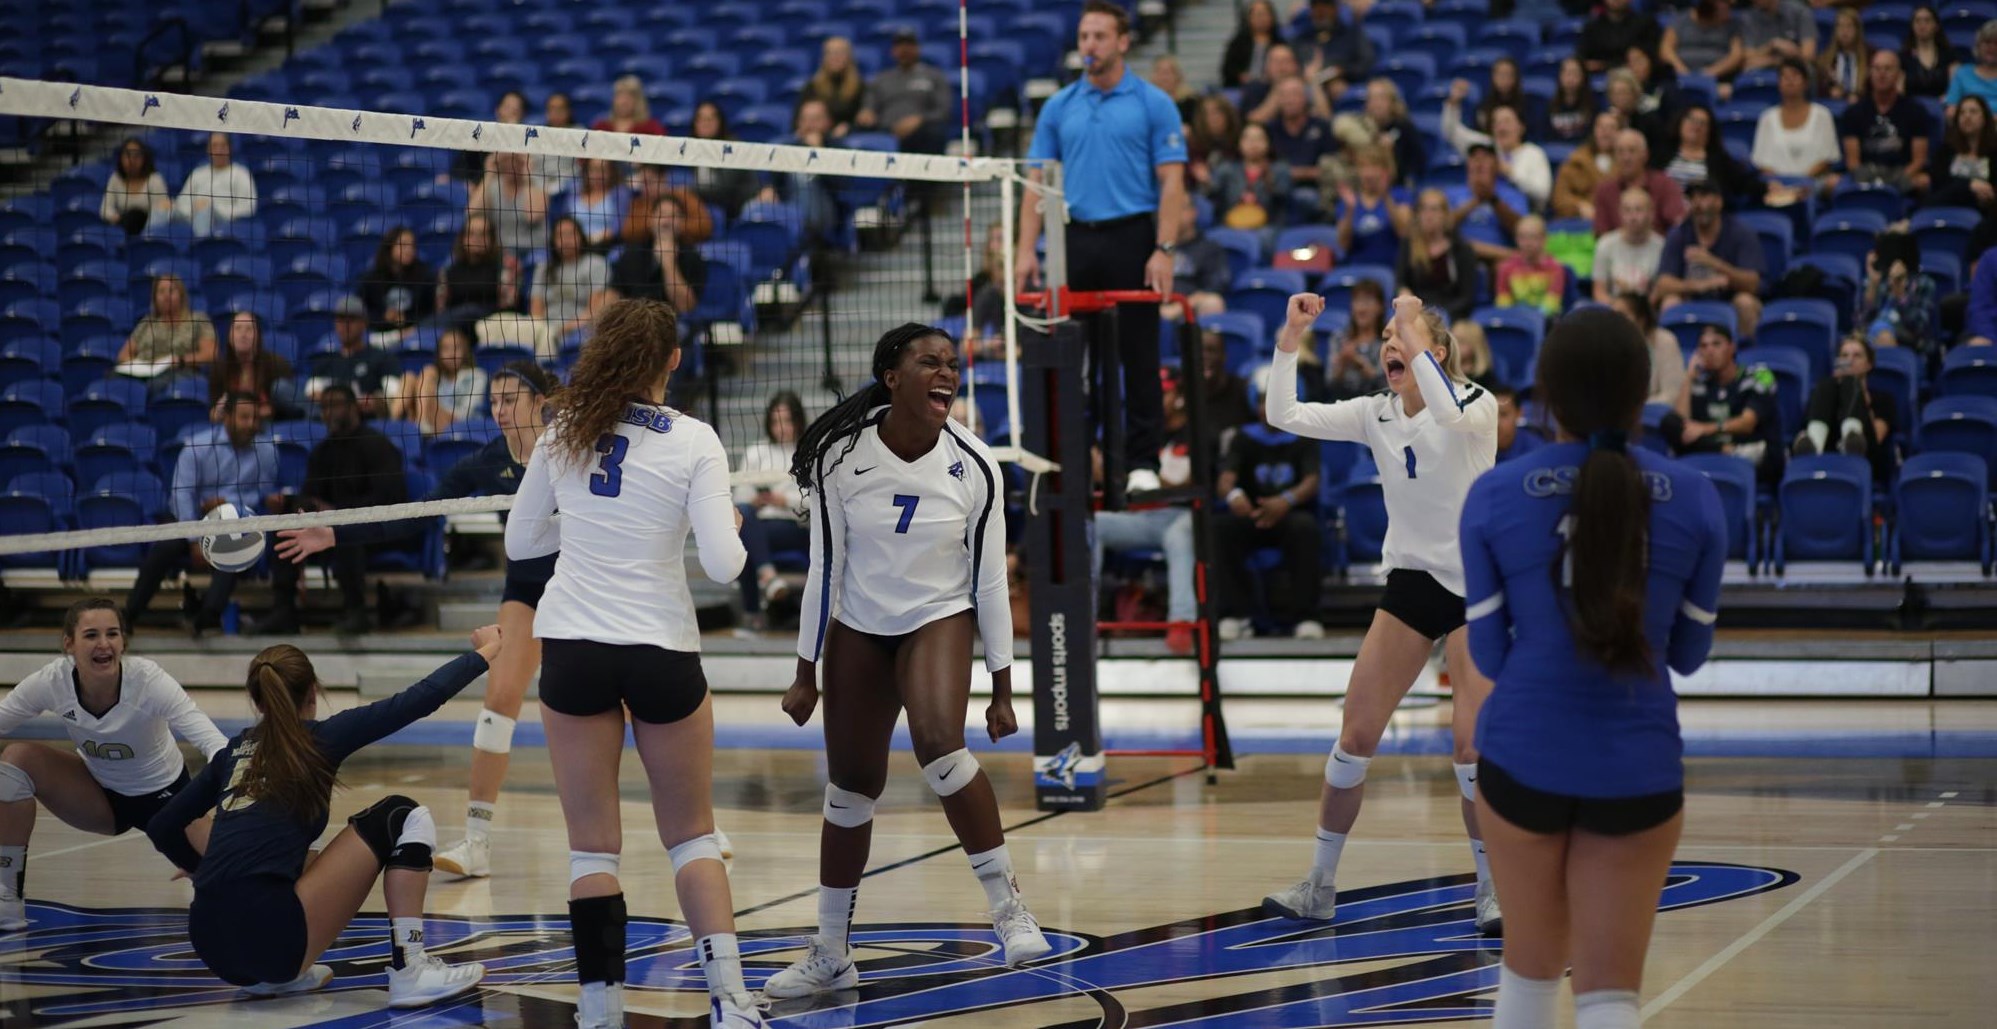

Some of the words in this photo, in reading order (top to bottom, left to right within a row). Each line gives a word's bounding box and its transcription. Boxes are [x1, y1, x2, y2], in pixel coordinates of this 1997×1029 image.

[589, 432, 630, 498] 3
[1403, 445, 1417, 479] 1
[1523, 466, 1673, 501] CSB
[892, 493, 920, 534] 7
[1048, 612, 1069, 665] sports
[1050, 666, 1071, 731] imports
